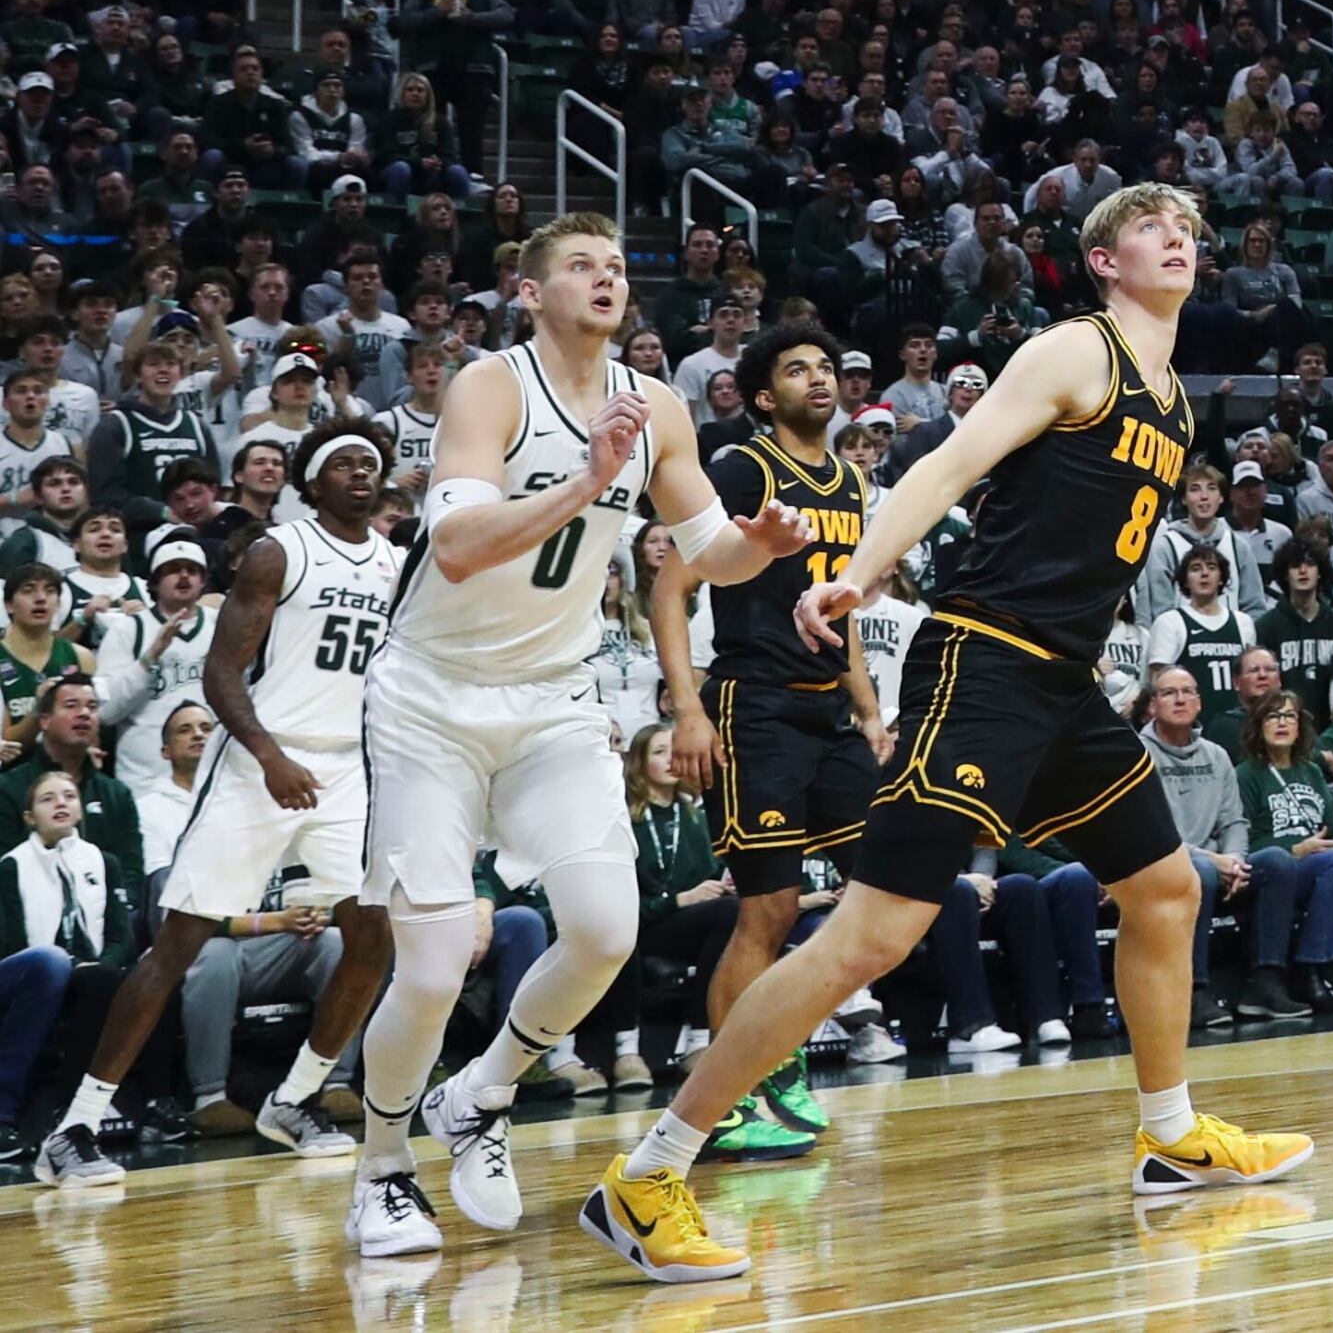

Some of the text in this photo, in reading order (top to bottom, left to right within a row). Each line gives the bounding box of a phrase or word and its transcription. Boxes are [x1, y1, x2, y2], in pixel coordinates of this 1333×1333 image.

[800, 507, 862, 545] OWA
[1114, 484, 1159, 565] 8
[530, 515, 587, 590] 0
[309, 586, 390, 616] State
[315, 614, 381, 676] 55
[1207, 660, 1232, 691] 11
